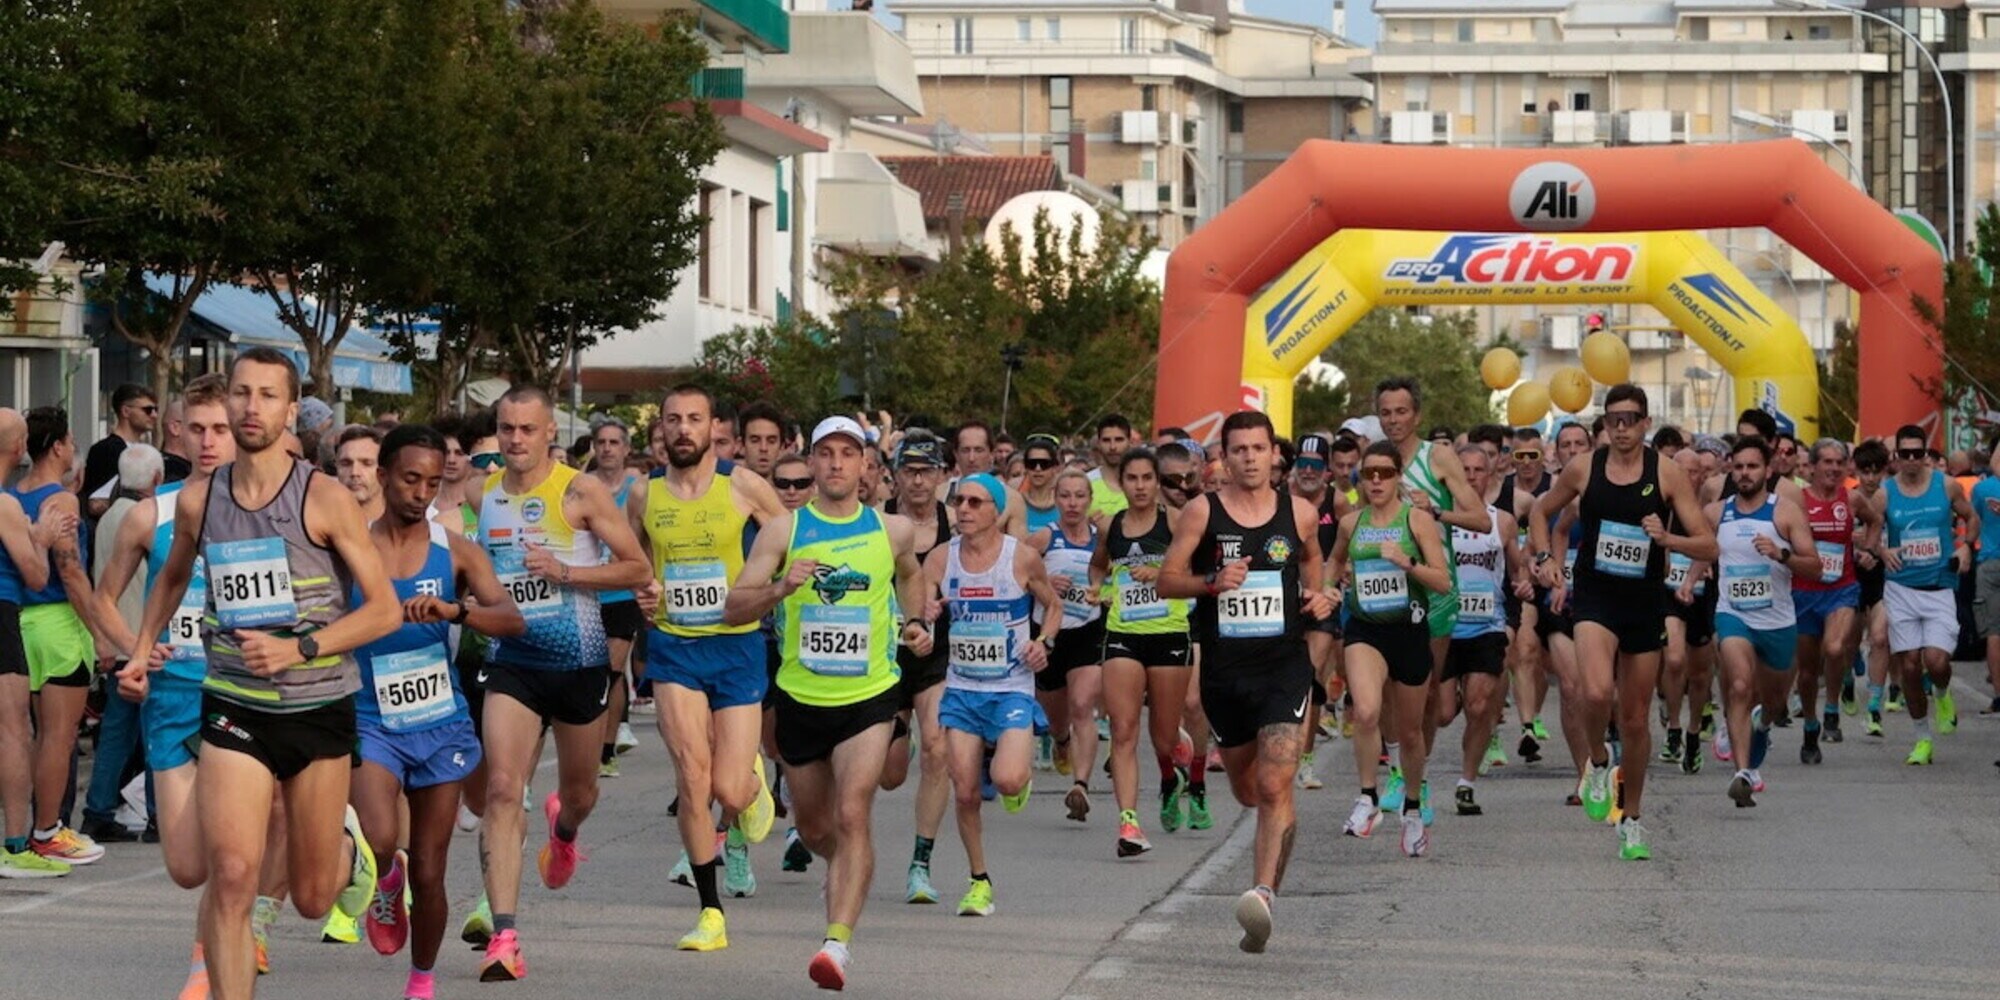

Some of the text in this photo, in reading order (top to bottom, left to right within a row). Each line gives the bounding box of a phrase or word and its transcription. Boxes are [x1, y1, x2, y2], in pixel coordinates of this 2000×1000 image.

[1384, 285, 1634, 295] INTEGRATORI PER LO SPORT
[1272, 289, 1349, 361] PROACTION.IT
[1667, 283, 1745, 351] PROACTION.IT
[1222, 542, 1241, 557] WE
[1604, 542, 1642, 563] 5459
[1907, 543, 1935, 557] 7406
[222, 569, 276, 602] 5811
[1364, 577, 1399, 596] 5004
[1732, 581, 1765, 597] 5623
[674, 586, 718, 607] 5180
[1126, 587, 1159, 606] 5280
[1227, 596, 1273, 617] 5117
[810, 631, 858, 654] 5524
[957, 643, 997, 662] 5344
[388, 673, 438, 706] 5607
